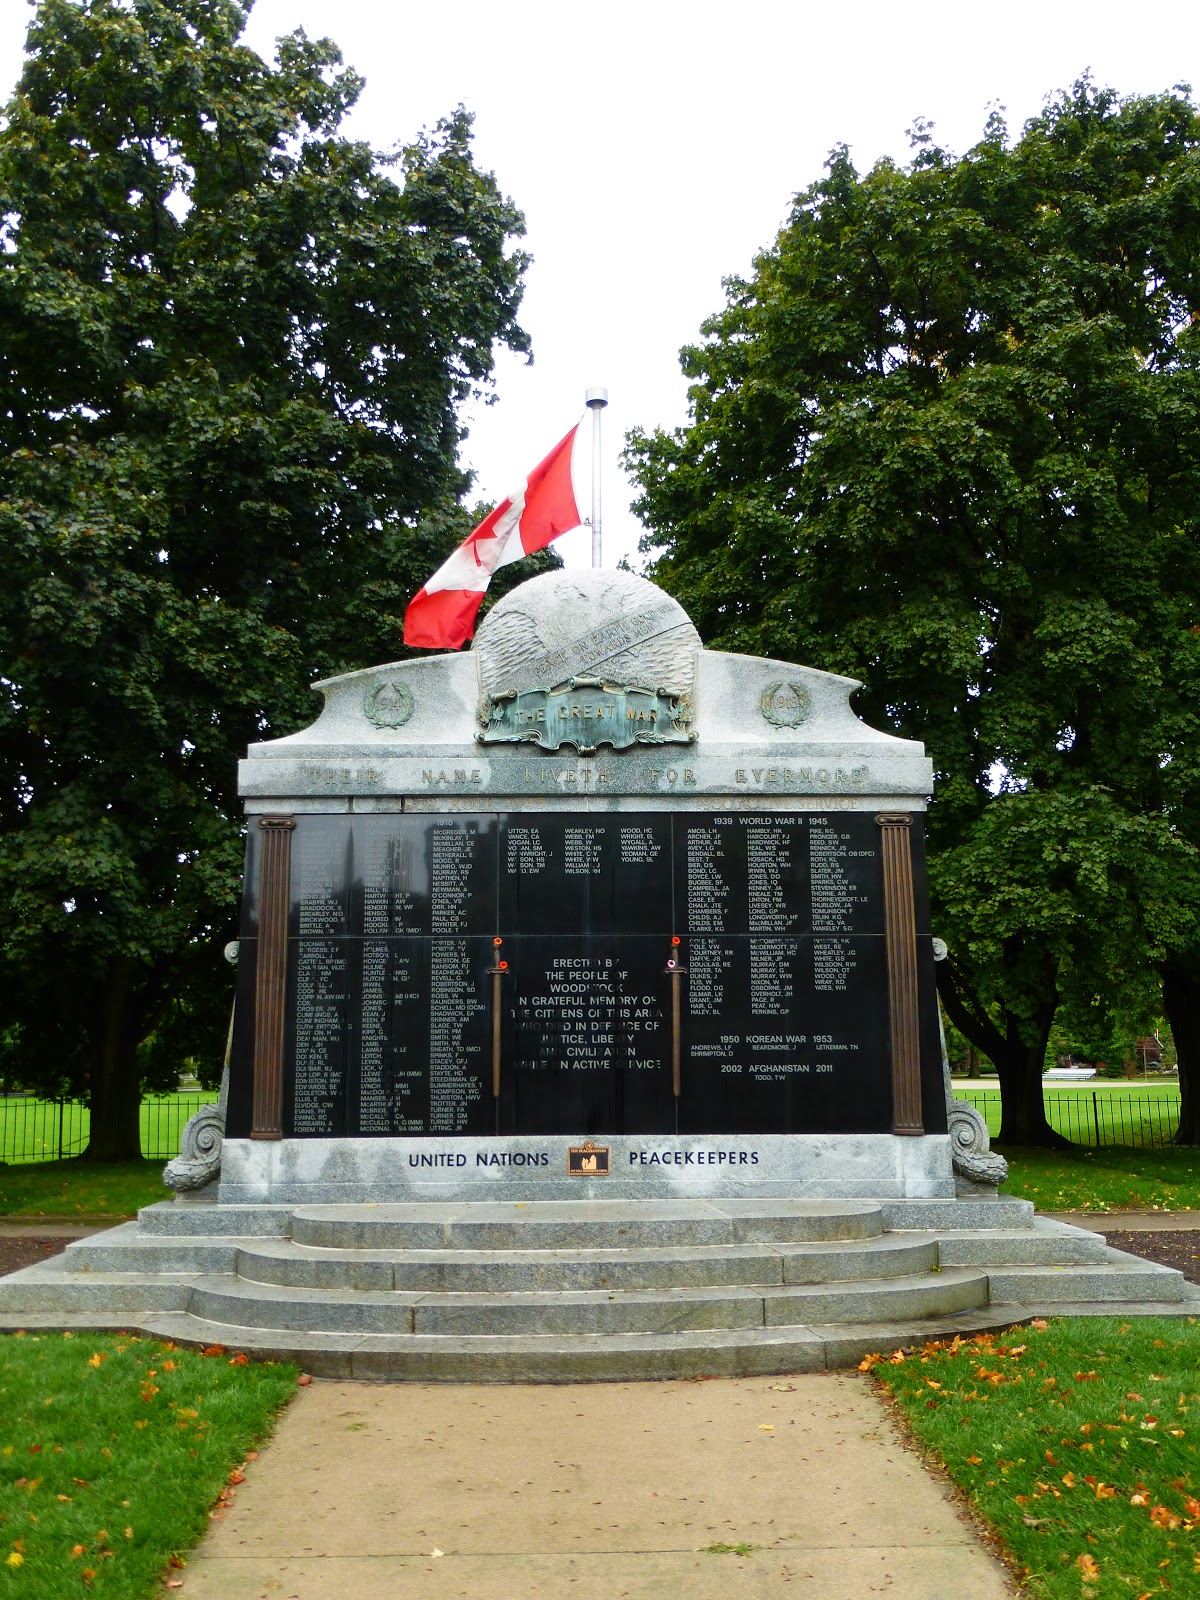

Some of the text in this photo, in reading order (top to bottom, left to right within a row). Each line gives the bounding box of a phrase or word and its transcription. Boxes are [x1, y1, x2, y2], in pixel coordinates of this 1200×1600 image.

[515, 704, 657, 726] THE GREAT WAR
[310, 770, 378, 785] THEIR
[422, 769, 482, 784] NAME
[524, 768, 608, 784] LIVETH
[651, 768, 695, 783] FOR
[546, 971, 564, 980] THE
[570, 971, 608, 980] PEOPLE
[532, 997, 585, 1005] GRATEFUL
[590, 996, 637, 1005] MEMORY
[642, 996, 656, 1005] OF
[588, 1009, 602, 1018] OF
[576, 1022, 586, 1031] IN
[645, 1022, 659, 1031] OF
[573, 1060, 610, 1069] ACTIVE
[409, 1151, 759, 1167] UNITED NATIONS PEACEKEEPERS
